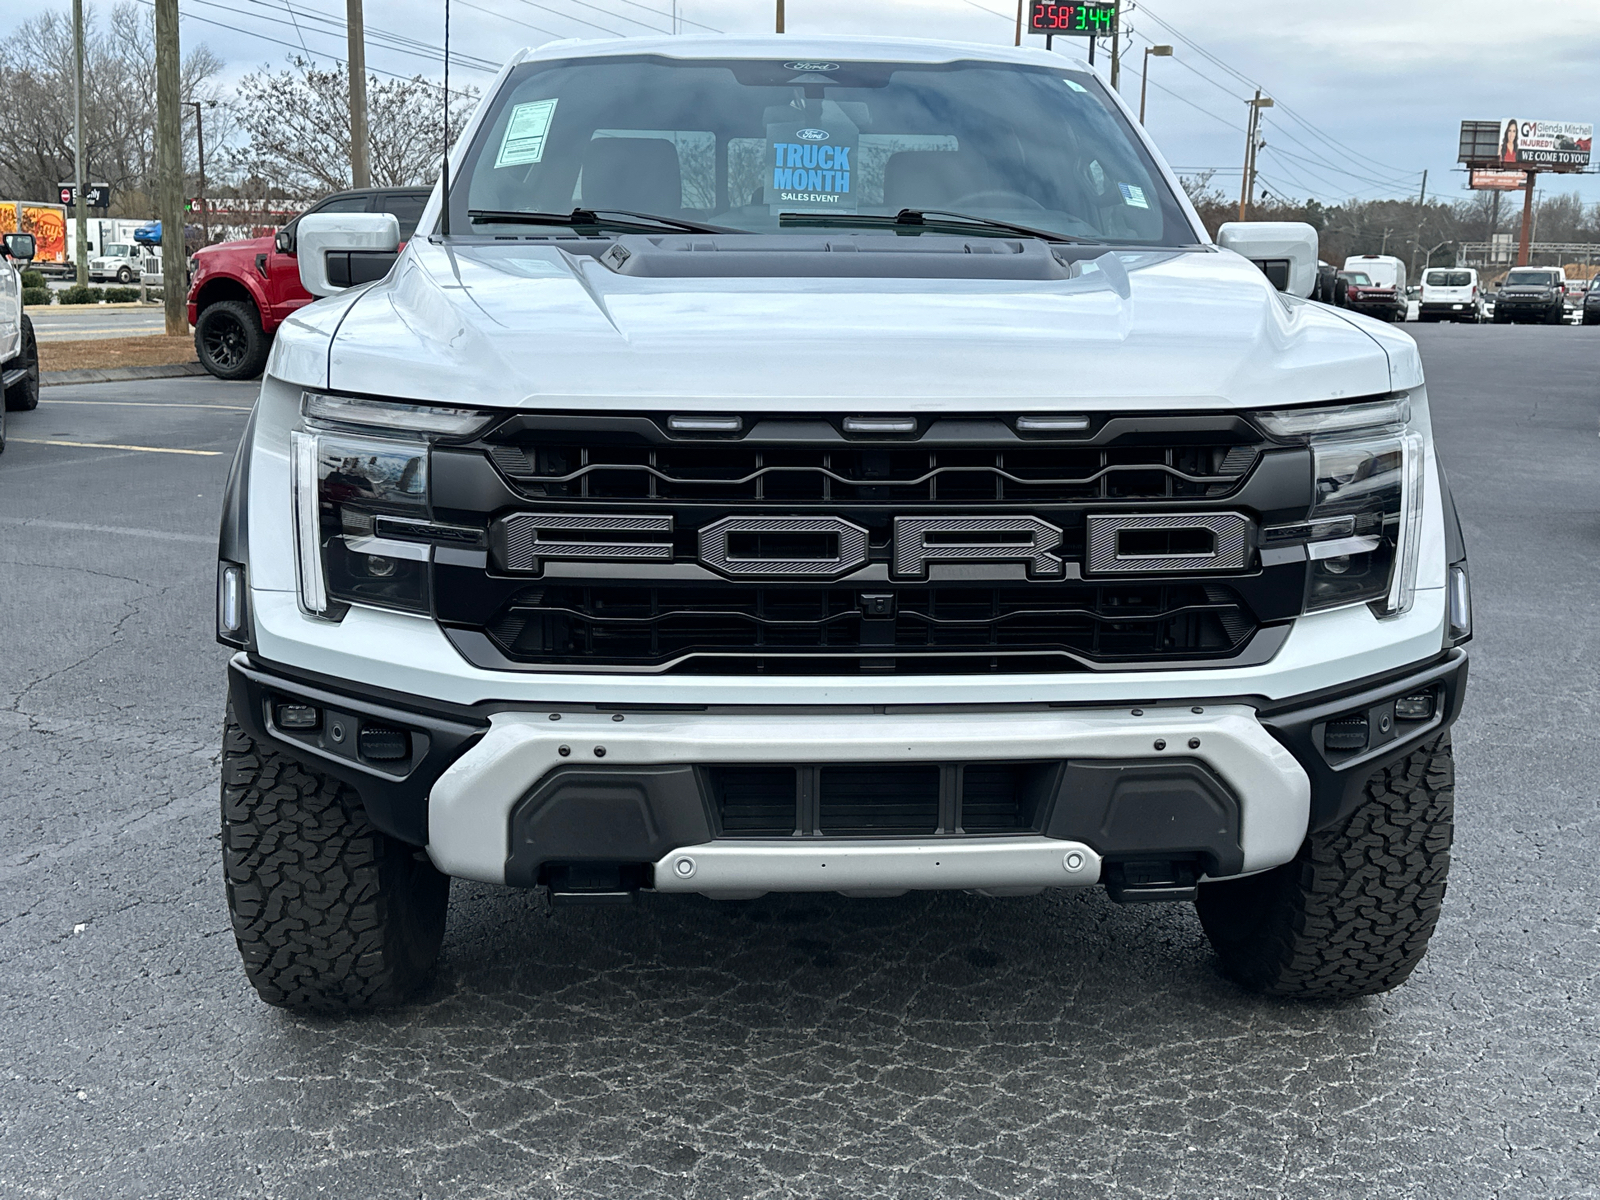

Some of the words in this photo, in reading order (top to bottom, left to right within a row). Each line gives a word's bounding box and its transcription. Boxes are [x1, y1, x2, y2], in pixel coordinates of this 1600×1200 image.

[793, 61, 830, 71] Ford
[802, 129, 824, 140] Ford
[1537, 123, 1562, 133] Glenda
[1564, 125, 1593, 136] Mitchell
[1520, 139, 1553, 148] INJURED?
[773, 142, 851, 171] TRUCK
[1521, 150, 1534, 161] WE
[1534, 151, 1557, 162] COME
[1559, 152, 1570, 163] TO
[1570, 153, 1589, 164] YOU!
[773, 167, 850, 193] MONTH
[780, 192, 809, 202] SALES
[810, 194, 840, 203] EVENT
[490, 511, 1257, 583] FORD
